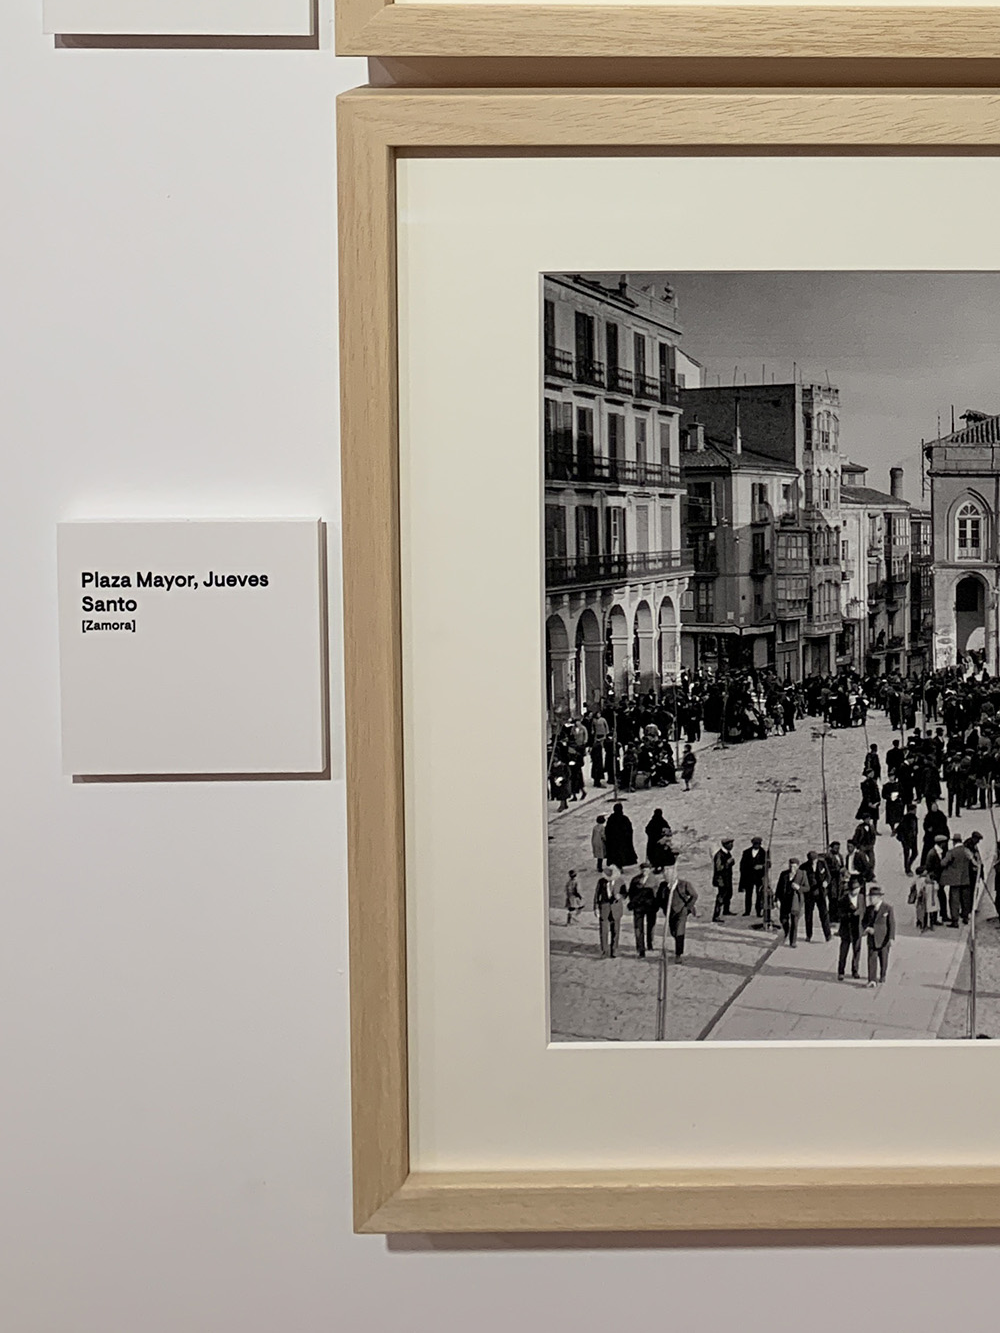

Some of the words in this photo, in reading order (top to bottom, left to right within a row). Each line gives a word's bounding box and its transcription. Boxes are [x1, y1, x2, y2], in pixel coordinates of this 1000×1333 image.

[82, 571, 132, 588] Plaza
[137, 572, 198, 591] Mayor,
[203, 571, 269, 587] Jueves
[82, 596, 137, 612] Santo
[82, 620, 136, 633] [Zamora]
